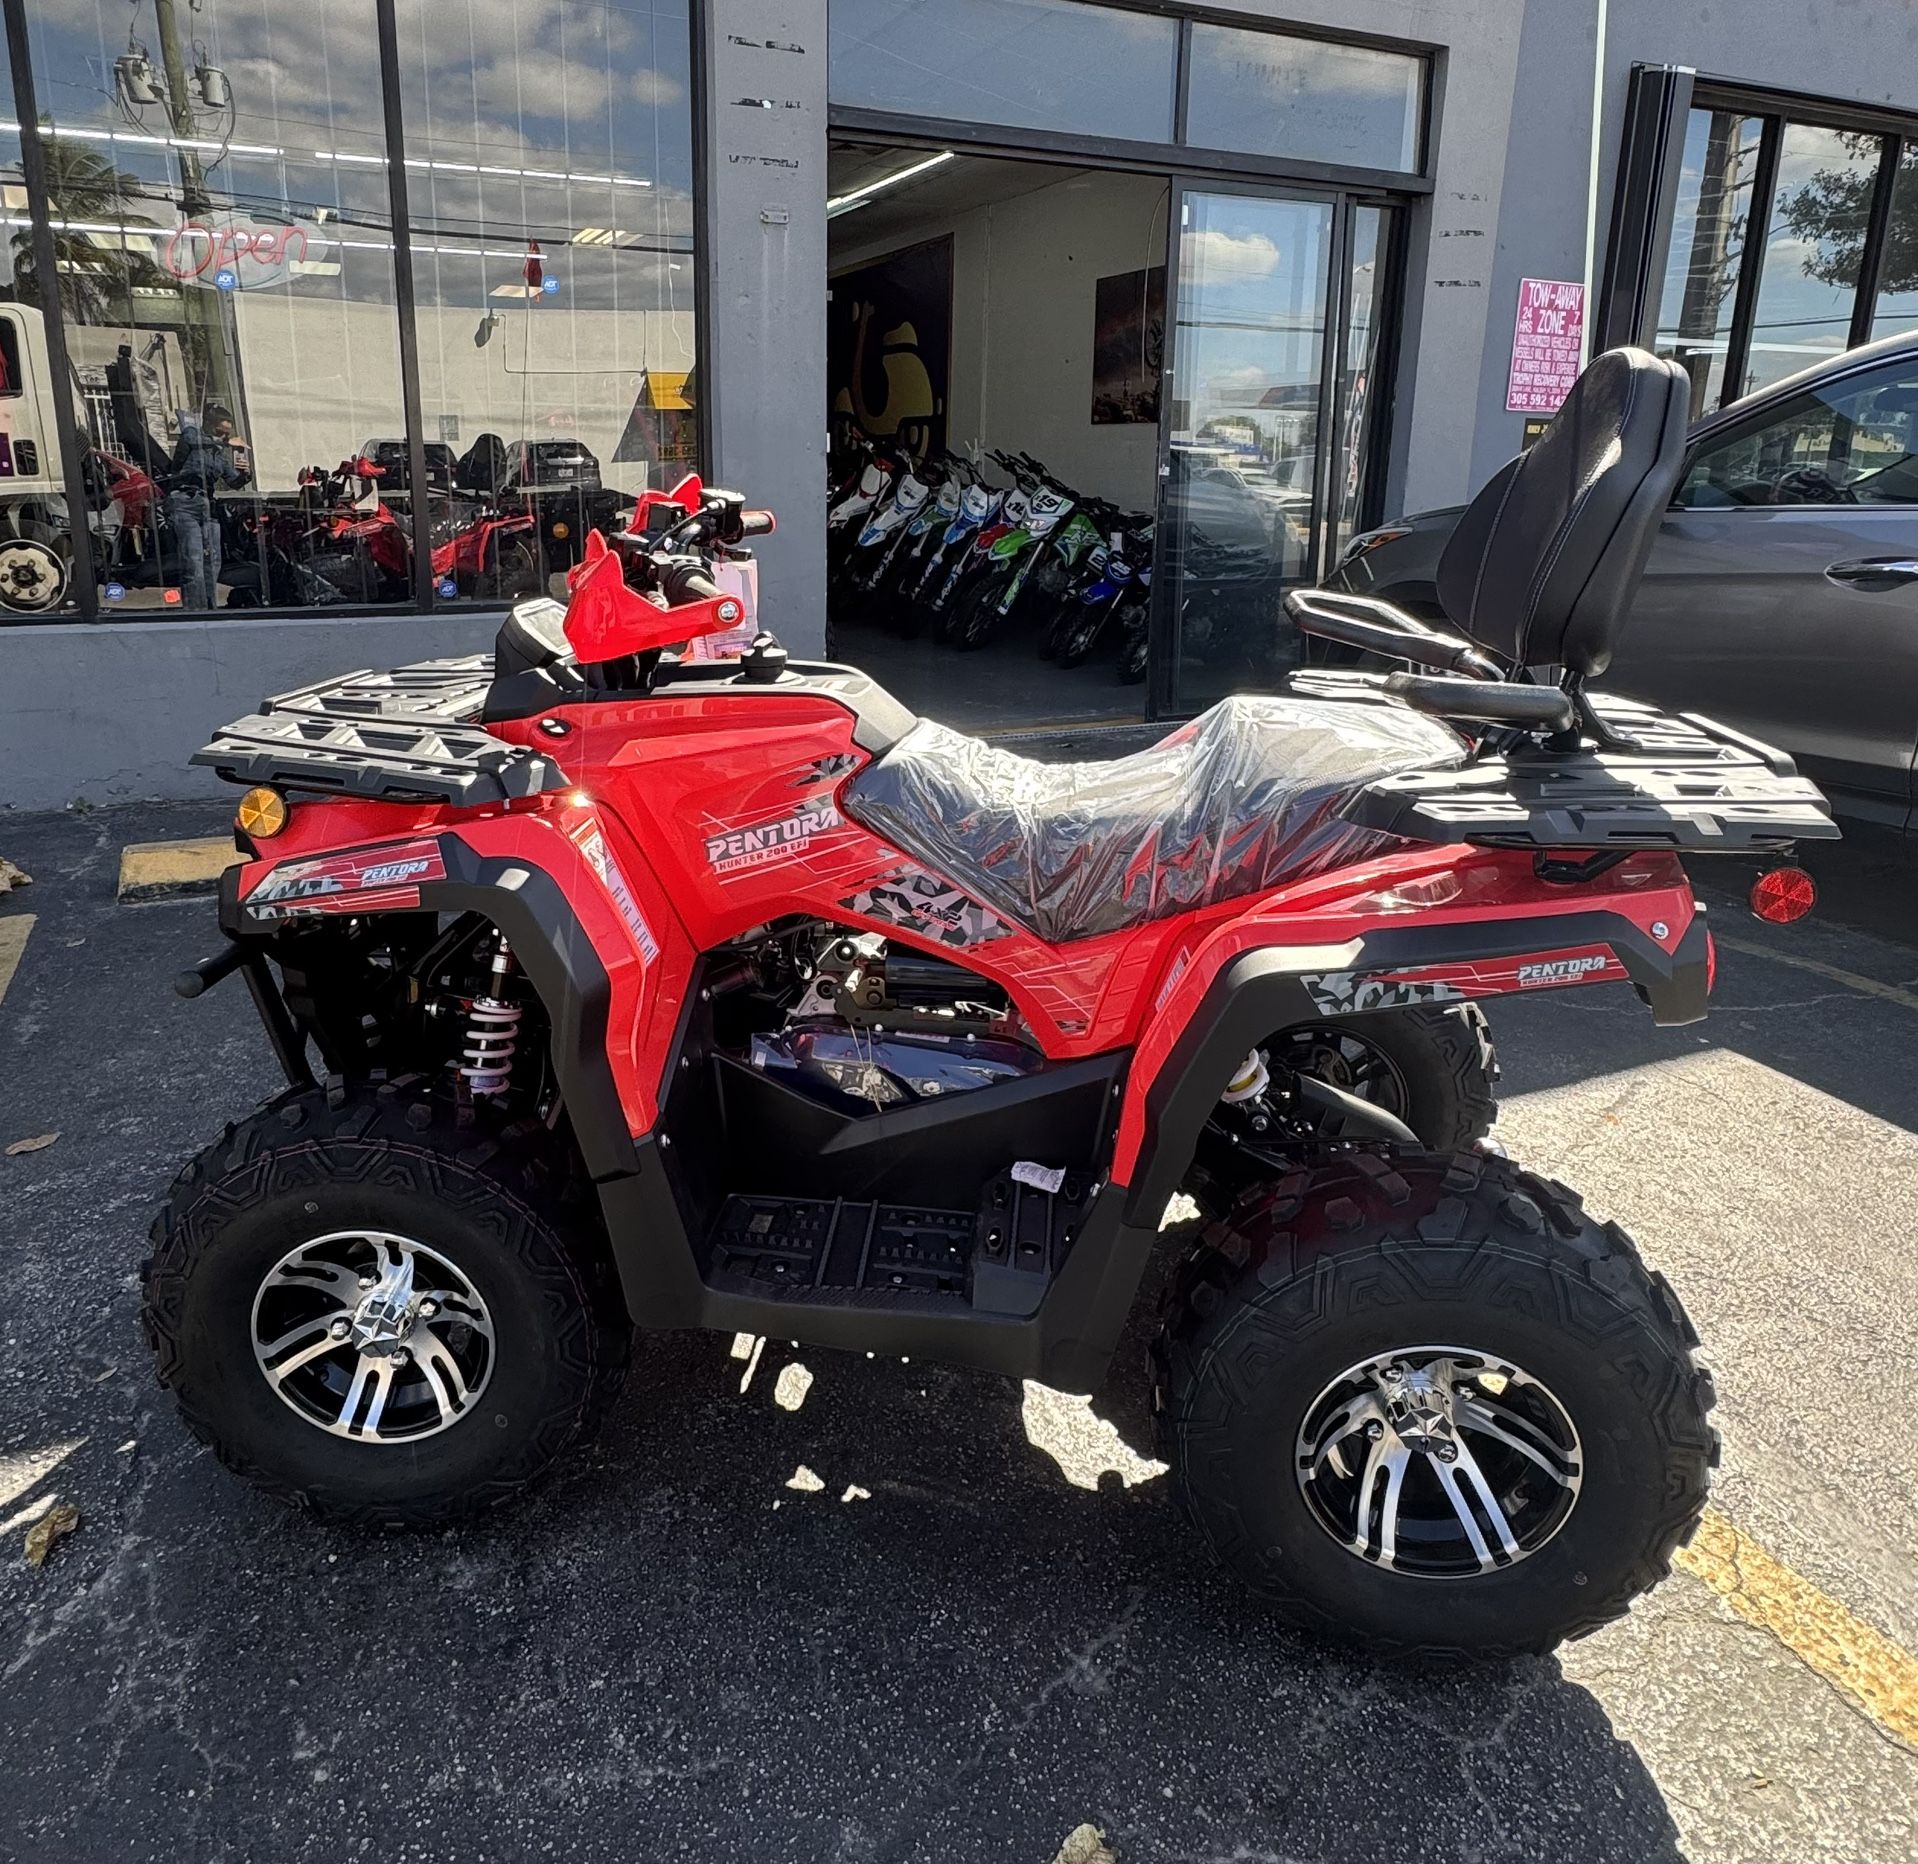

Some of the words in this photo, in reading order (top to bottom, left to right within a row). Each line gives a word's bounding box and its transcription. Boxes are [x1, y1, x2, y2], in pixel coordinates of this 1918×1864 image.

[166, 221, 308, 279] Open
[1528, 282, 1583, 310] TOW-AWAY
[1522, 306, 1533, 320] 24
[1536, 309, 1567, 335] ZONE
[1573, 311, 1581, 324] 7
[1510, 392, 1528, 405] 305
[1529, 394, 1547, 407] 592
[705, 806, 839, 862] PENTORA
[718, 851, 765, 872] HUNTER
[790, 838, 808, 851] EFI
[361, 860, 429, 881] PENTORA
[1517, 956, 1607, 980] PENTORA
